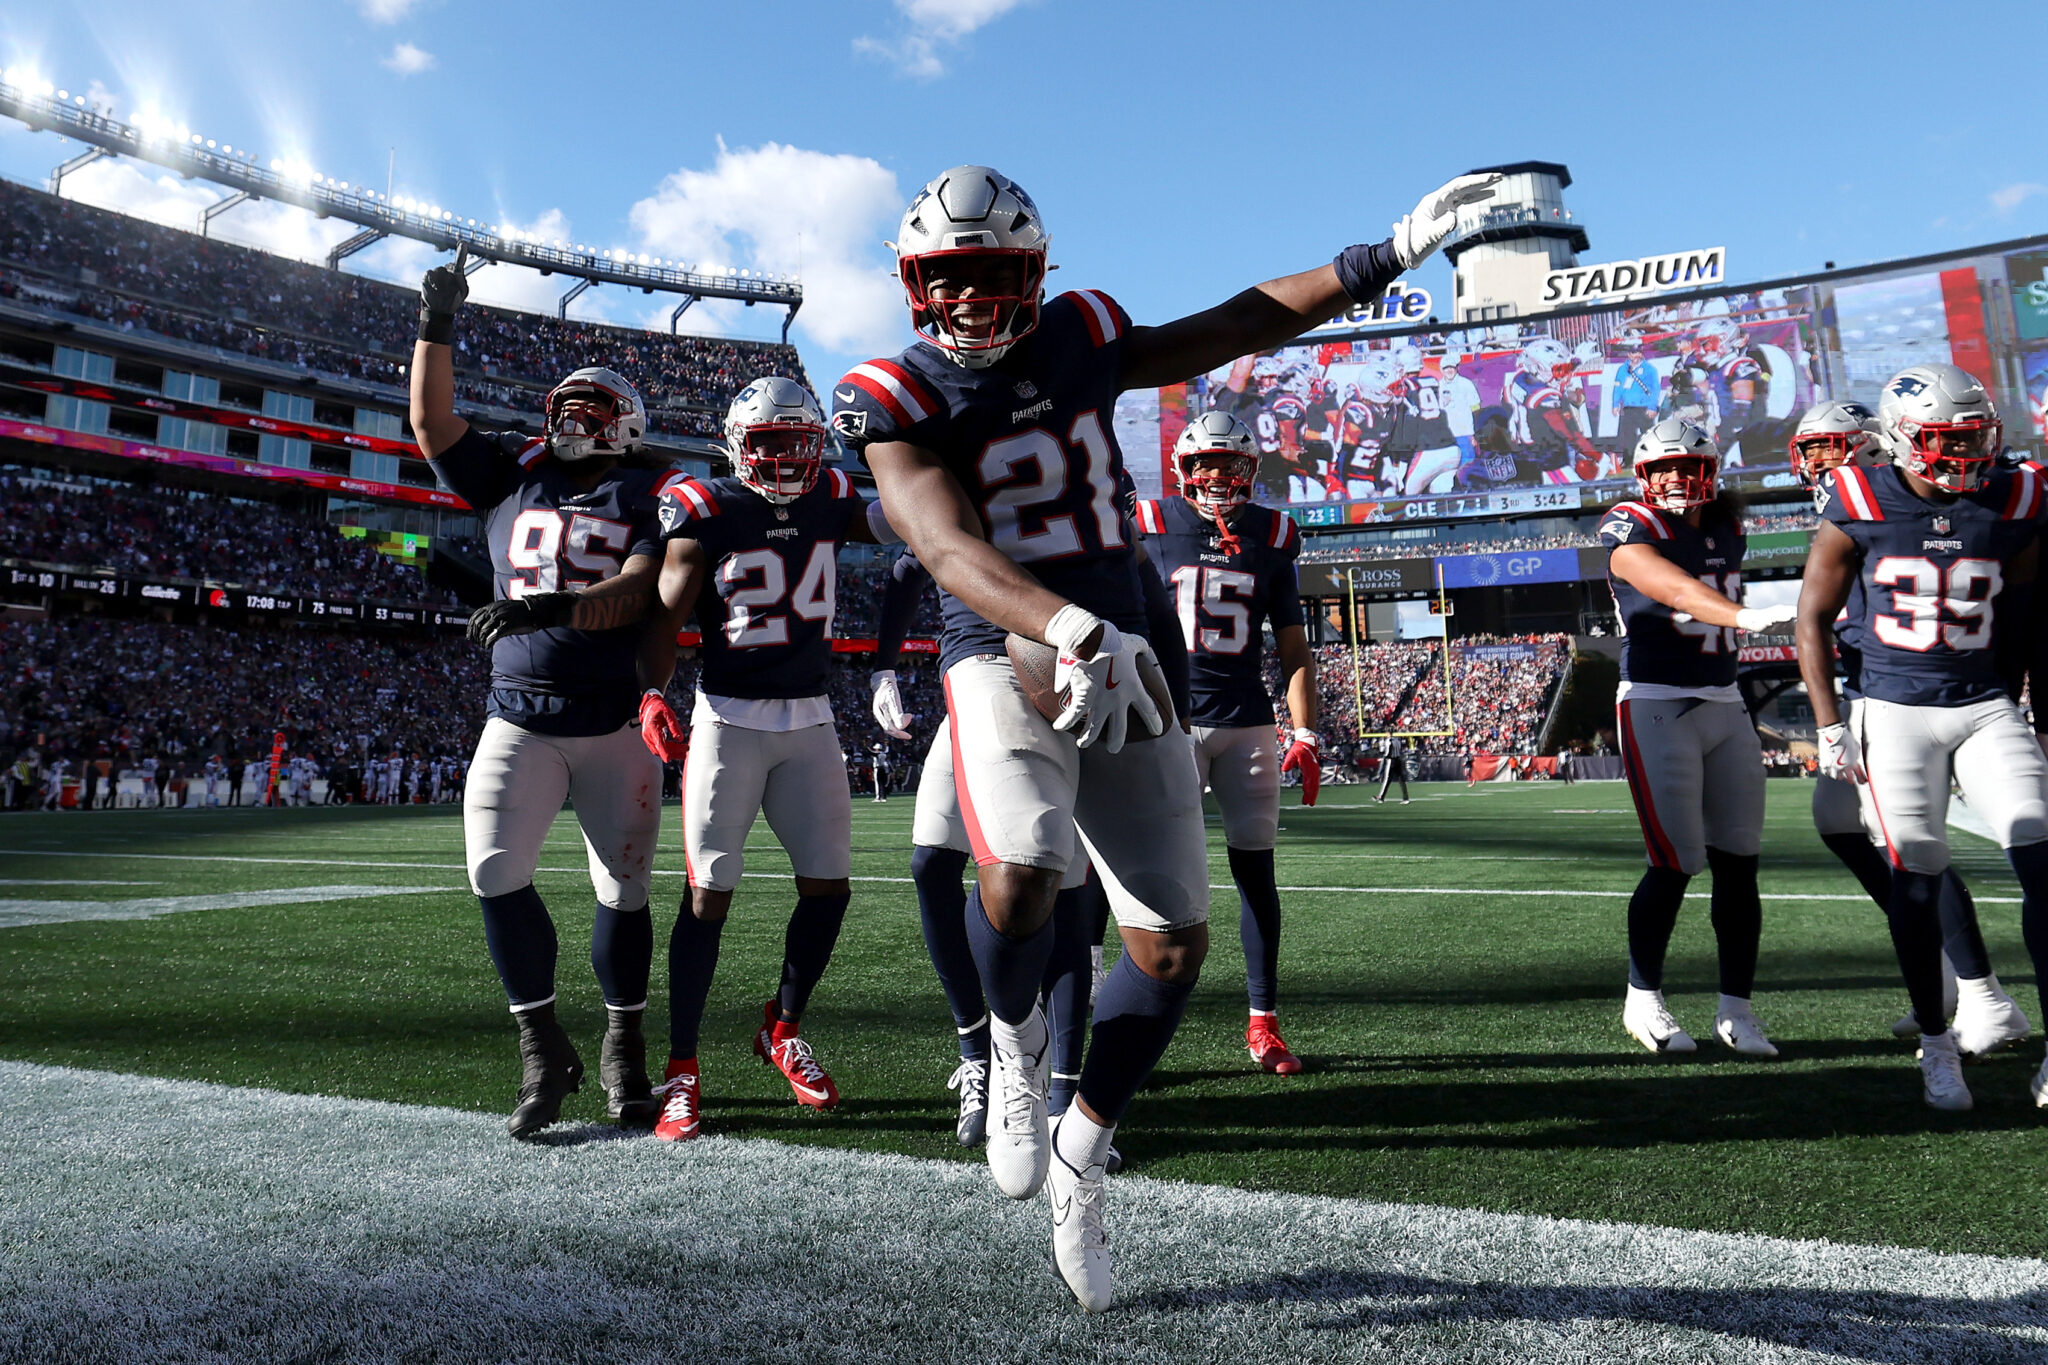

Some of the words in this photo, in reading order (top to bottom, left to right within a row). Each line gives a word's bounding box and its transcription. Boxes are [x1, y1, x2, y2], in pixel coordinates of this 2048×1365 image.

[1543, 251, 1720, 302] STADIUM
[1012, 399, 1053, 424] PATRIOTS
[976, 408, 1128, 563] 21
[1308, 509, 1325, 524] 23
[1405, 501, 1438, 518] CLE
[1456, 500, 1466, 513] 7
[1534, 492, 1568, 507] 3:42
[766, 528, 799, 540] PATRIOTS
[1923, 540, 1963, 550] PATRIOTS
[508, 508, 633, 600] 95
[1200, 554, 1230, 564] PATRIOTS
[1751, 546, 1805, 560] paycom
[39, 573, 55, 587] 10
[100, 579, 117, 594] 26
[141, 585, 181, 600] Gillette
[722, 540, 838, 650] 24
[1351, 580, 1402, 589] NSURANCE
[246, 595, 275, 610] 17:08
[312, 602, 326, 614] 75
[375, 608, 388, 620] 53
[434, 614, 442, 625] 6
[1170, 566, 1256, 654] 15
[1873, 556, 2004, 652] 39
[1739, 646, 1786, 661] YOTA
